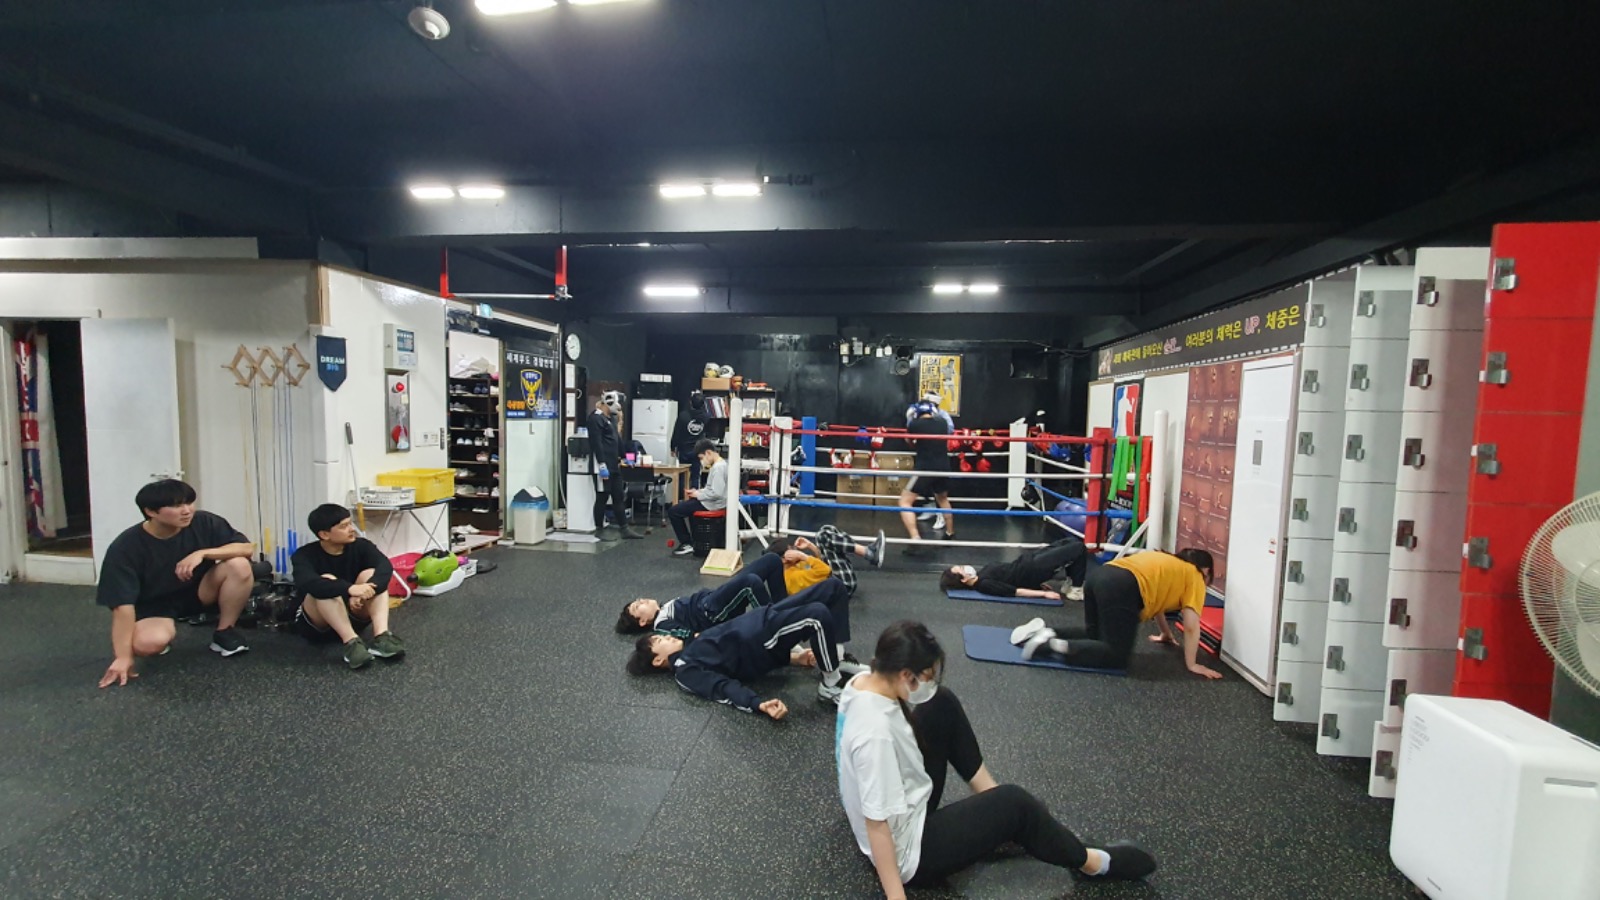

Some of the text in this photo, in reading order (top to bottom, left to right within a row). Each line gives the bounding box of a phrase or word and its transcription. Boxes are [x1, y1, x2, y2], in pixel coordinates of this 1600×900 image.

[1185, 328, 1214, 347] 여러분의
[1216, 320, 1242, 341] 체력은
[1265, 305, 1300, 330] 체중은
[320, 356, 345, 364] DREAM
